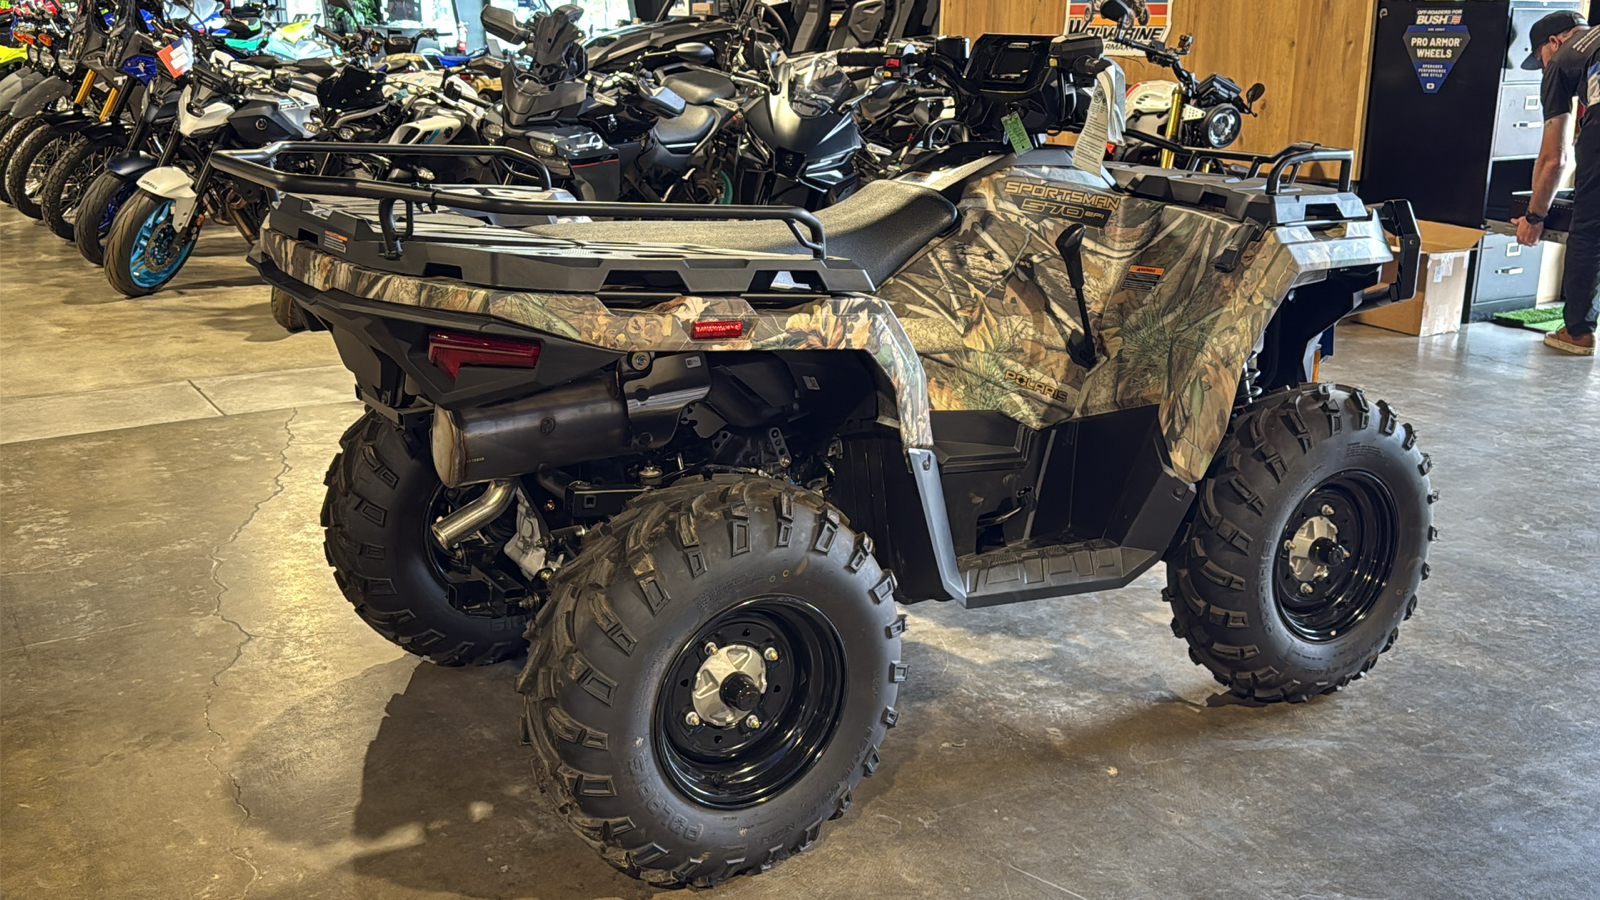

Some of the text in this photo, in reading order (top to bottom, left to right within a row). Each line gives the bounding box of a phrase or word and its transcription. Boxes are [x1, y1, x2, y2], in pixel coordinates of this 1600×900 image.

[1416, 15, 1449, 24] BUSH
[1411, 37, 1460, 47] PRO ARMOR
[1416, 48, 1453, 58] WHEELS
[1004, 181, 1120, 209] SPORTSMAN
[1021, 198, 1084, 219] 570
[1004, 370, 1068, 402] POLARIS
